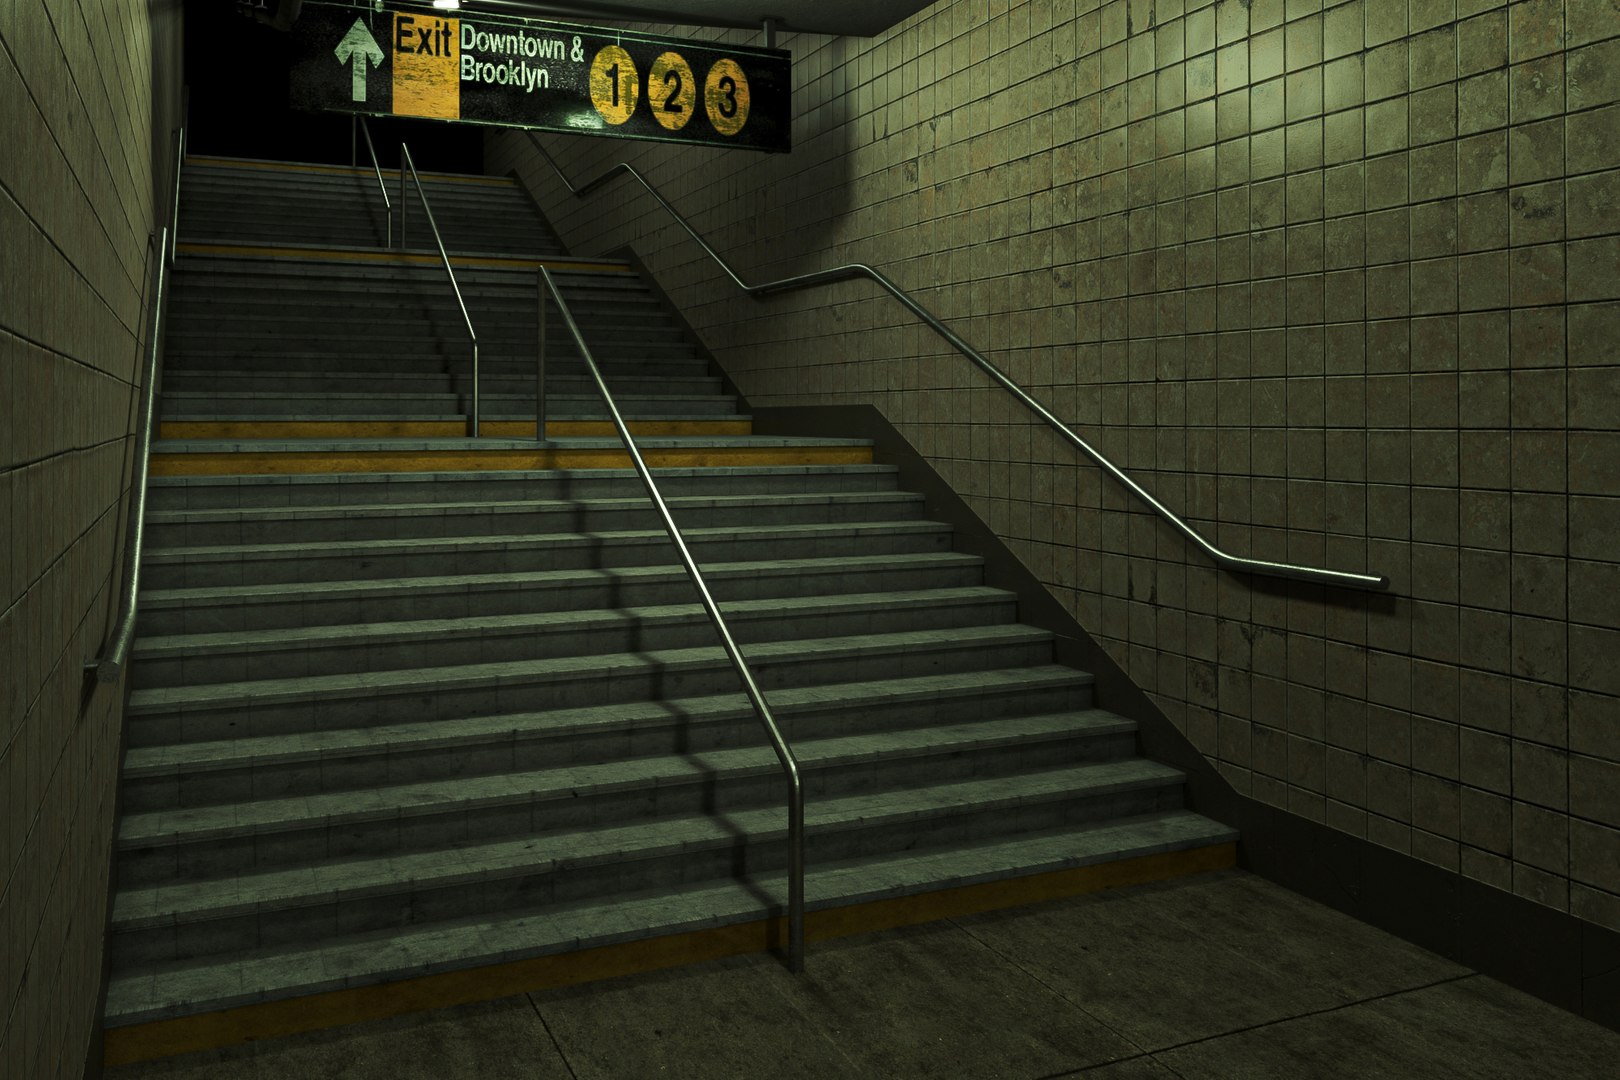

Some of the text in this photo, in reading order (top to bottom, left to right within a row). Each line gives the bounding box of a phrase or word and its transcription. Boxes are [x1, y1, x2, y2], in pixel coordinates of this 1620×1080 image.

[395, 17, 452, 57] Exit
[460, 25, 584, 63] Downtown &
[460, 54, 549, 93] Brooklyn
[605, 64, 737, 118] 1 2 3
